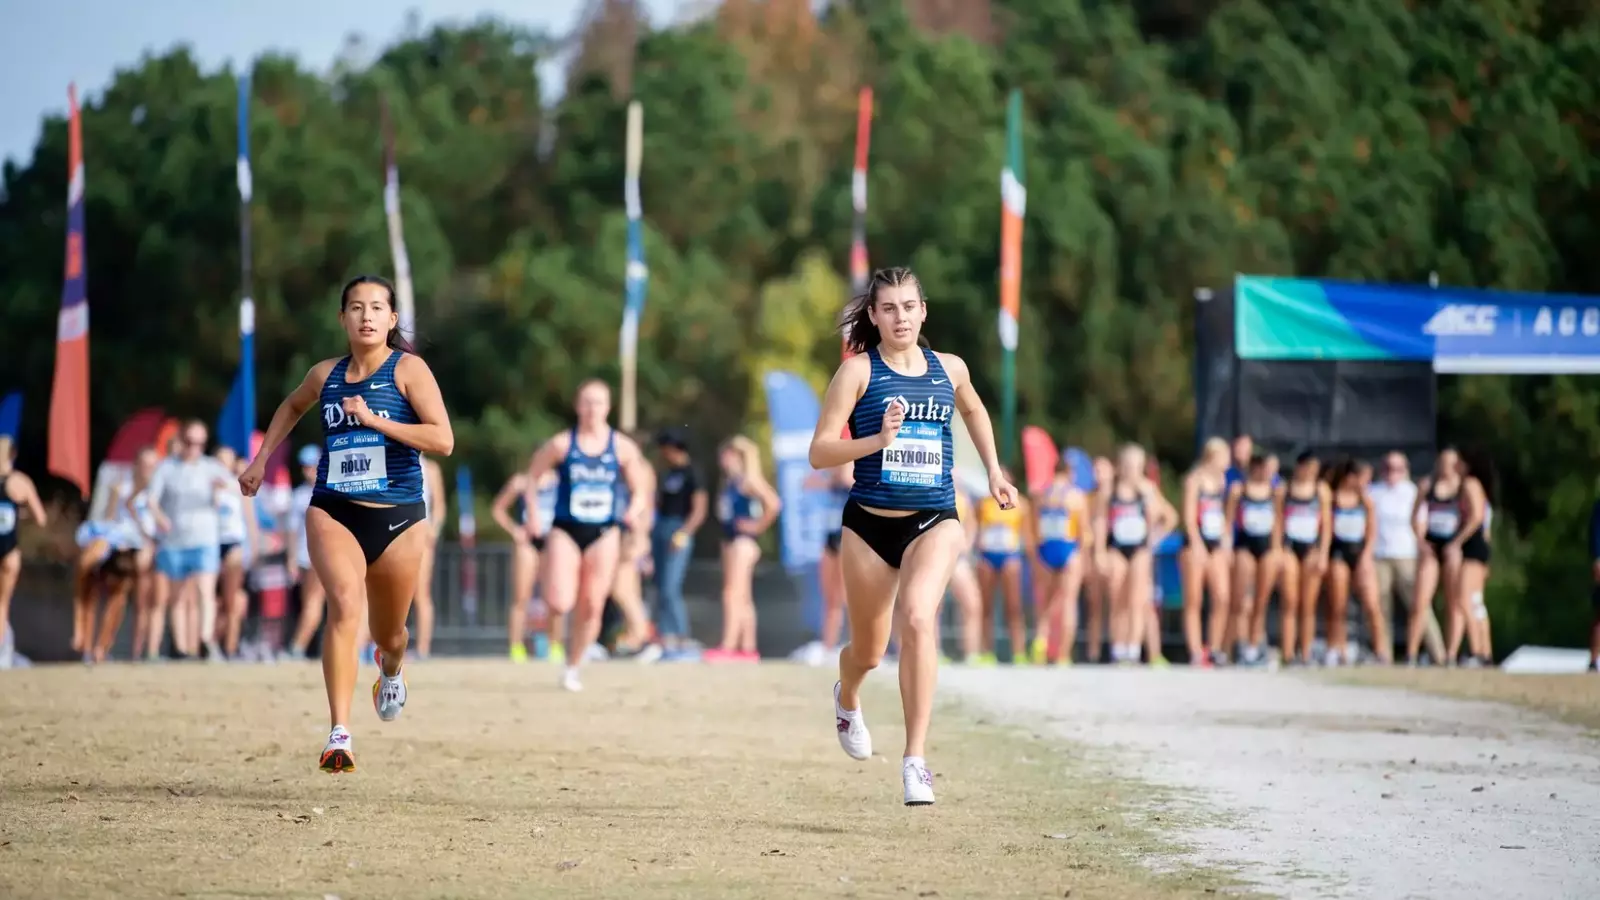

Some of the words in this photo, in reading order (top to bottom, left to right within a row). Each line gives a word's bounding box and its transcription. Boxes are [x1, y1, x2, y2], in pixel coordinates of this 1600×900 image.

[1422, 304, 1498, 336] ACC
[323, 402, 391, 429] Due
[332, 436, 349, 447] ACC
[885, 449, 941, 465] REYNOLDS
[341, 458, 371, 474] ROLLY
[890, 475, 936, 485] CHAMPIONSHIPS
[334, 484, 380, 493] CHAMPIONSHIPS
